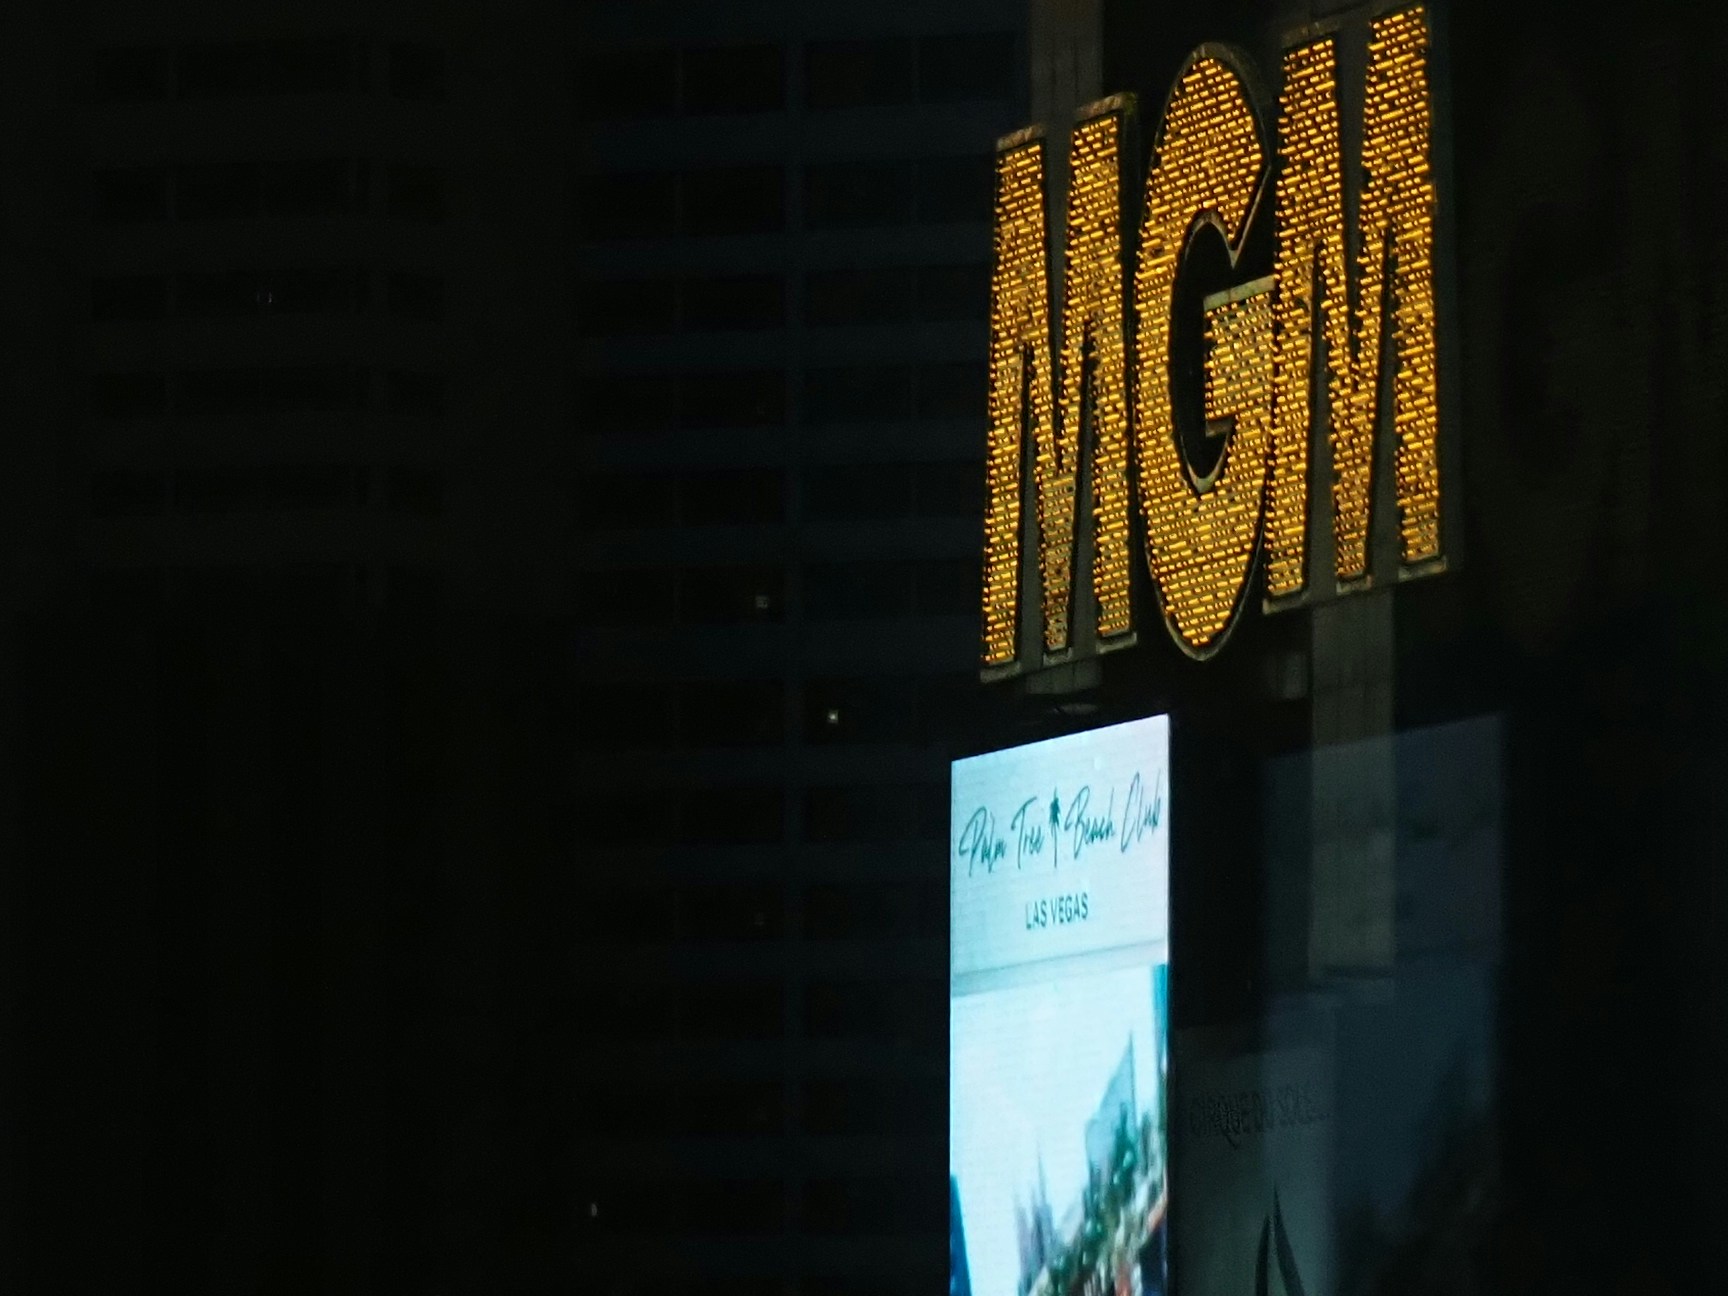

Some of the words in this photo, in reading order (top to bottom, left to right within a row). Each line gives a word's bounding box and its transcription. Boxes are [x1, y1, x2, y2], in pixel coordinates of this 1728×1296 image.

[958, 805, 1006, 878] Palm
[1010, 795, 1045, 870] Tree
[1064, 785, 1115, 860] Beach
[1120, 768, 1161, 853] Club
[1024, 900, 1047, 931] LAS
[1050, 891, 1089, 925] VEGAS
